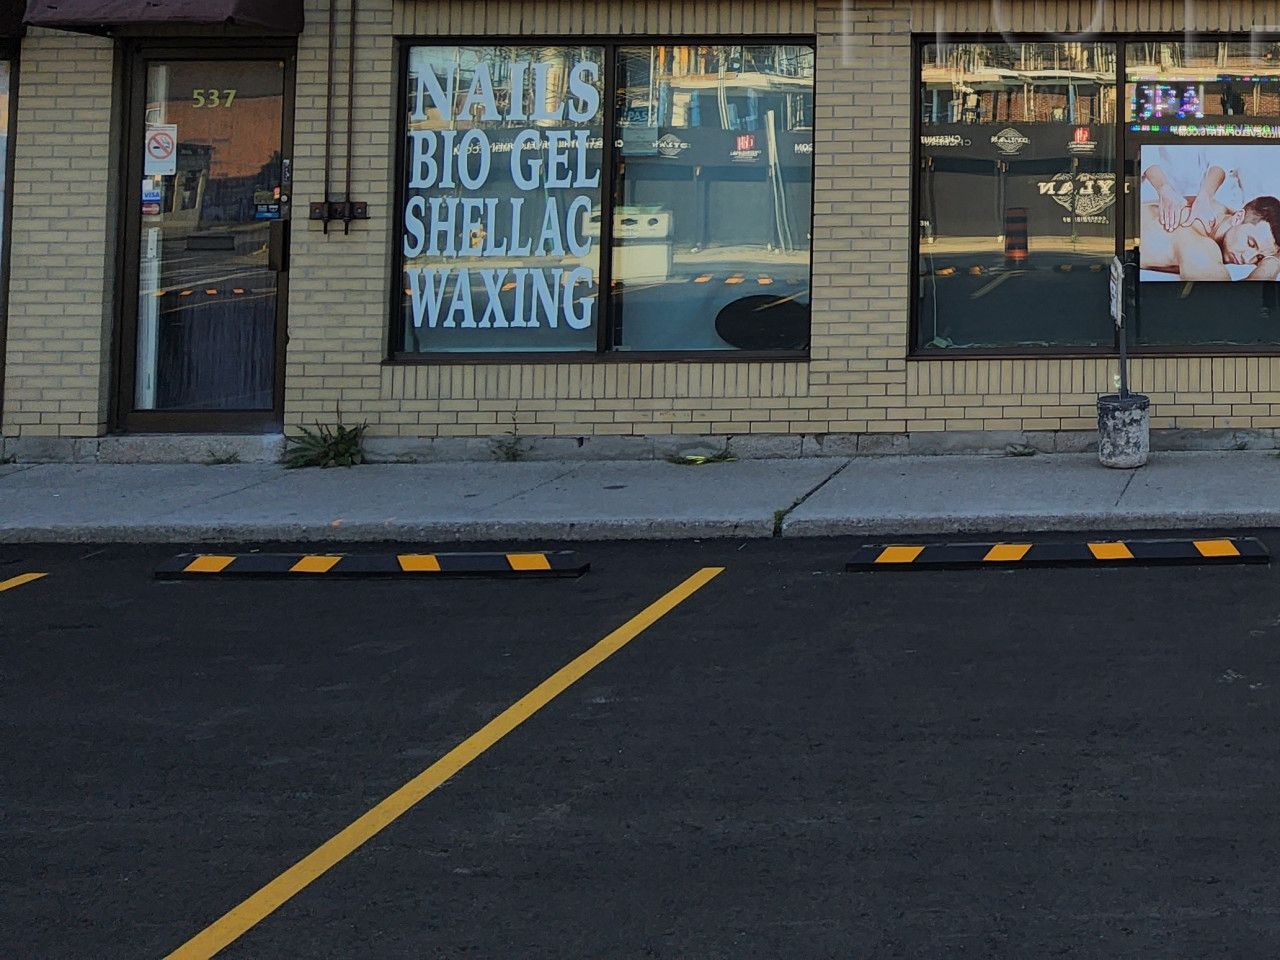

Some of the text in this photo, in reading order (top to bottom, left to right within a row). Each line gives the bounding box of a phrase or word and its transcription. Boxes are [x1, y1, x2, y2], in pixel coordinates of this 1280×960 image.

[192, 89, 237, 108] 537
[408, 61, 600, 123] NAILS
[408, 128, 600, 190] BIO GEL
[403, 195, 592, 258] SHELLAC
[406, 266, 595, 329] WAXING
